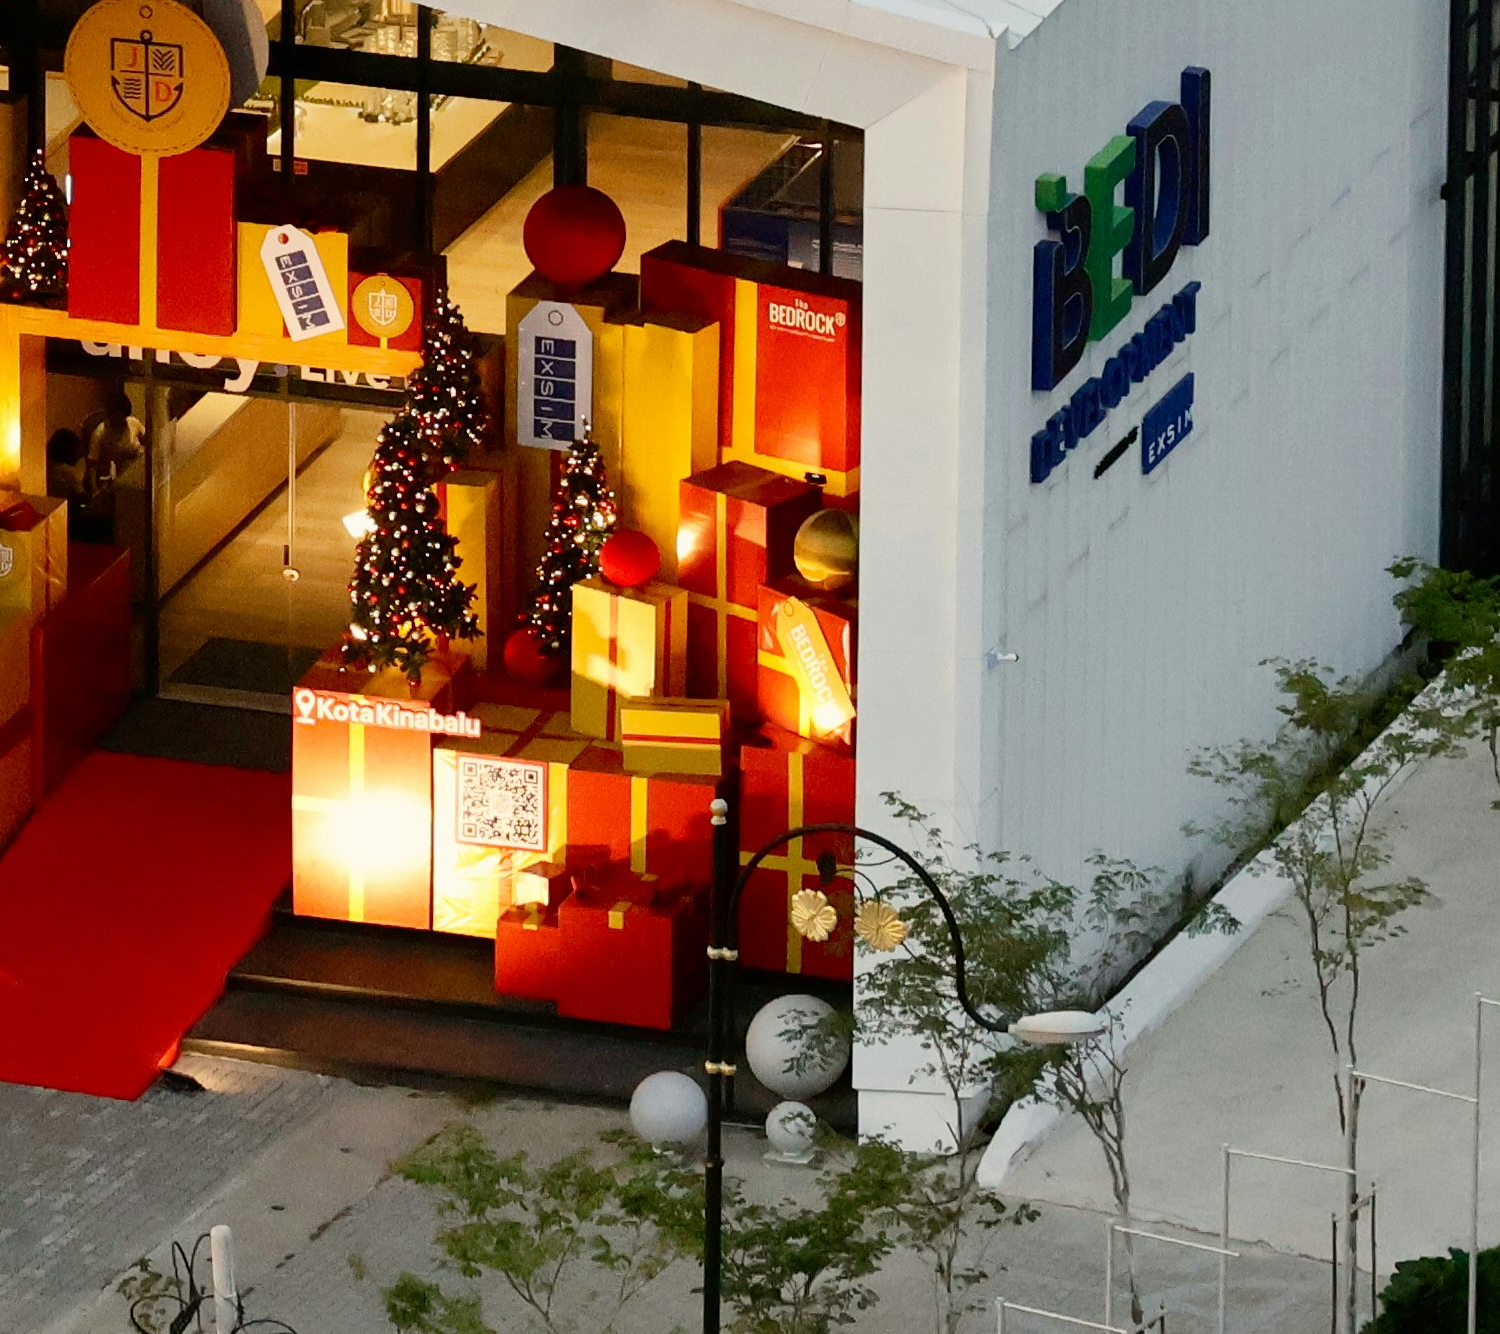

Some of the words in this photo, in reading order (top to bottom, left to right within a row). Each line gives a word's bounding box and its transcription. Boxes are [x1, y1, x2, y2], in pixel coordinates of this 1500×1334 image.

[1031, 65, 1211, 392] BEDI
[769, 302, 836, 336] BEDROCK
[1147, 403, 1194, 464] EXSIM
[790, 623, 838, 709] BEDROC
